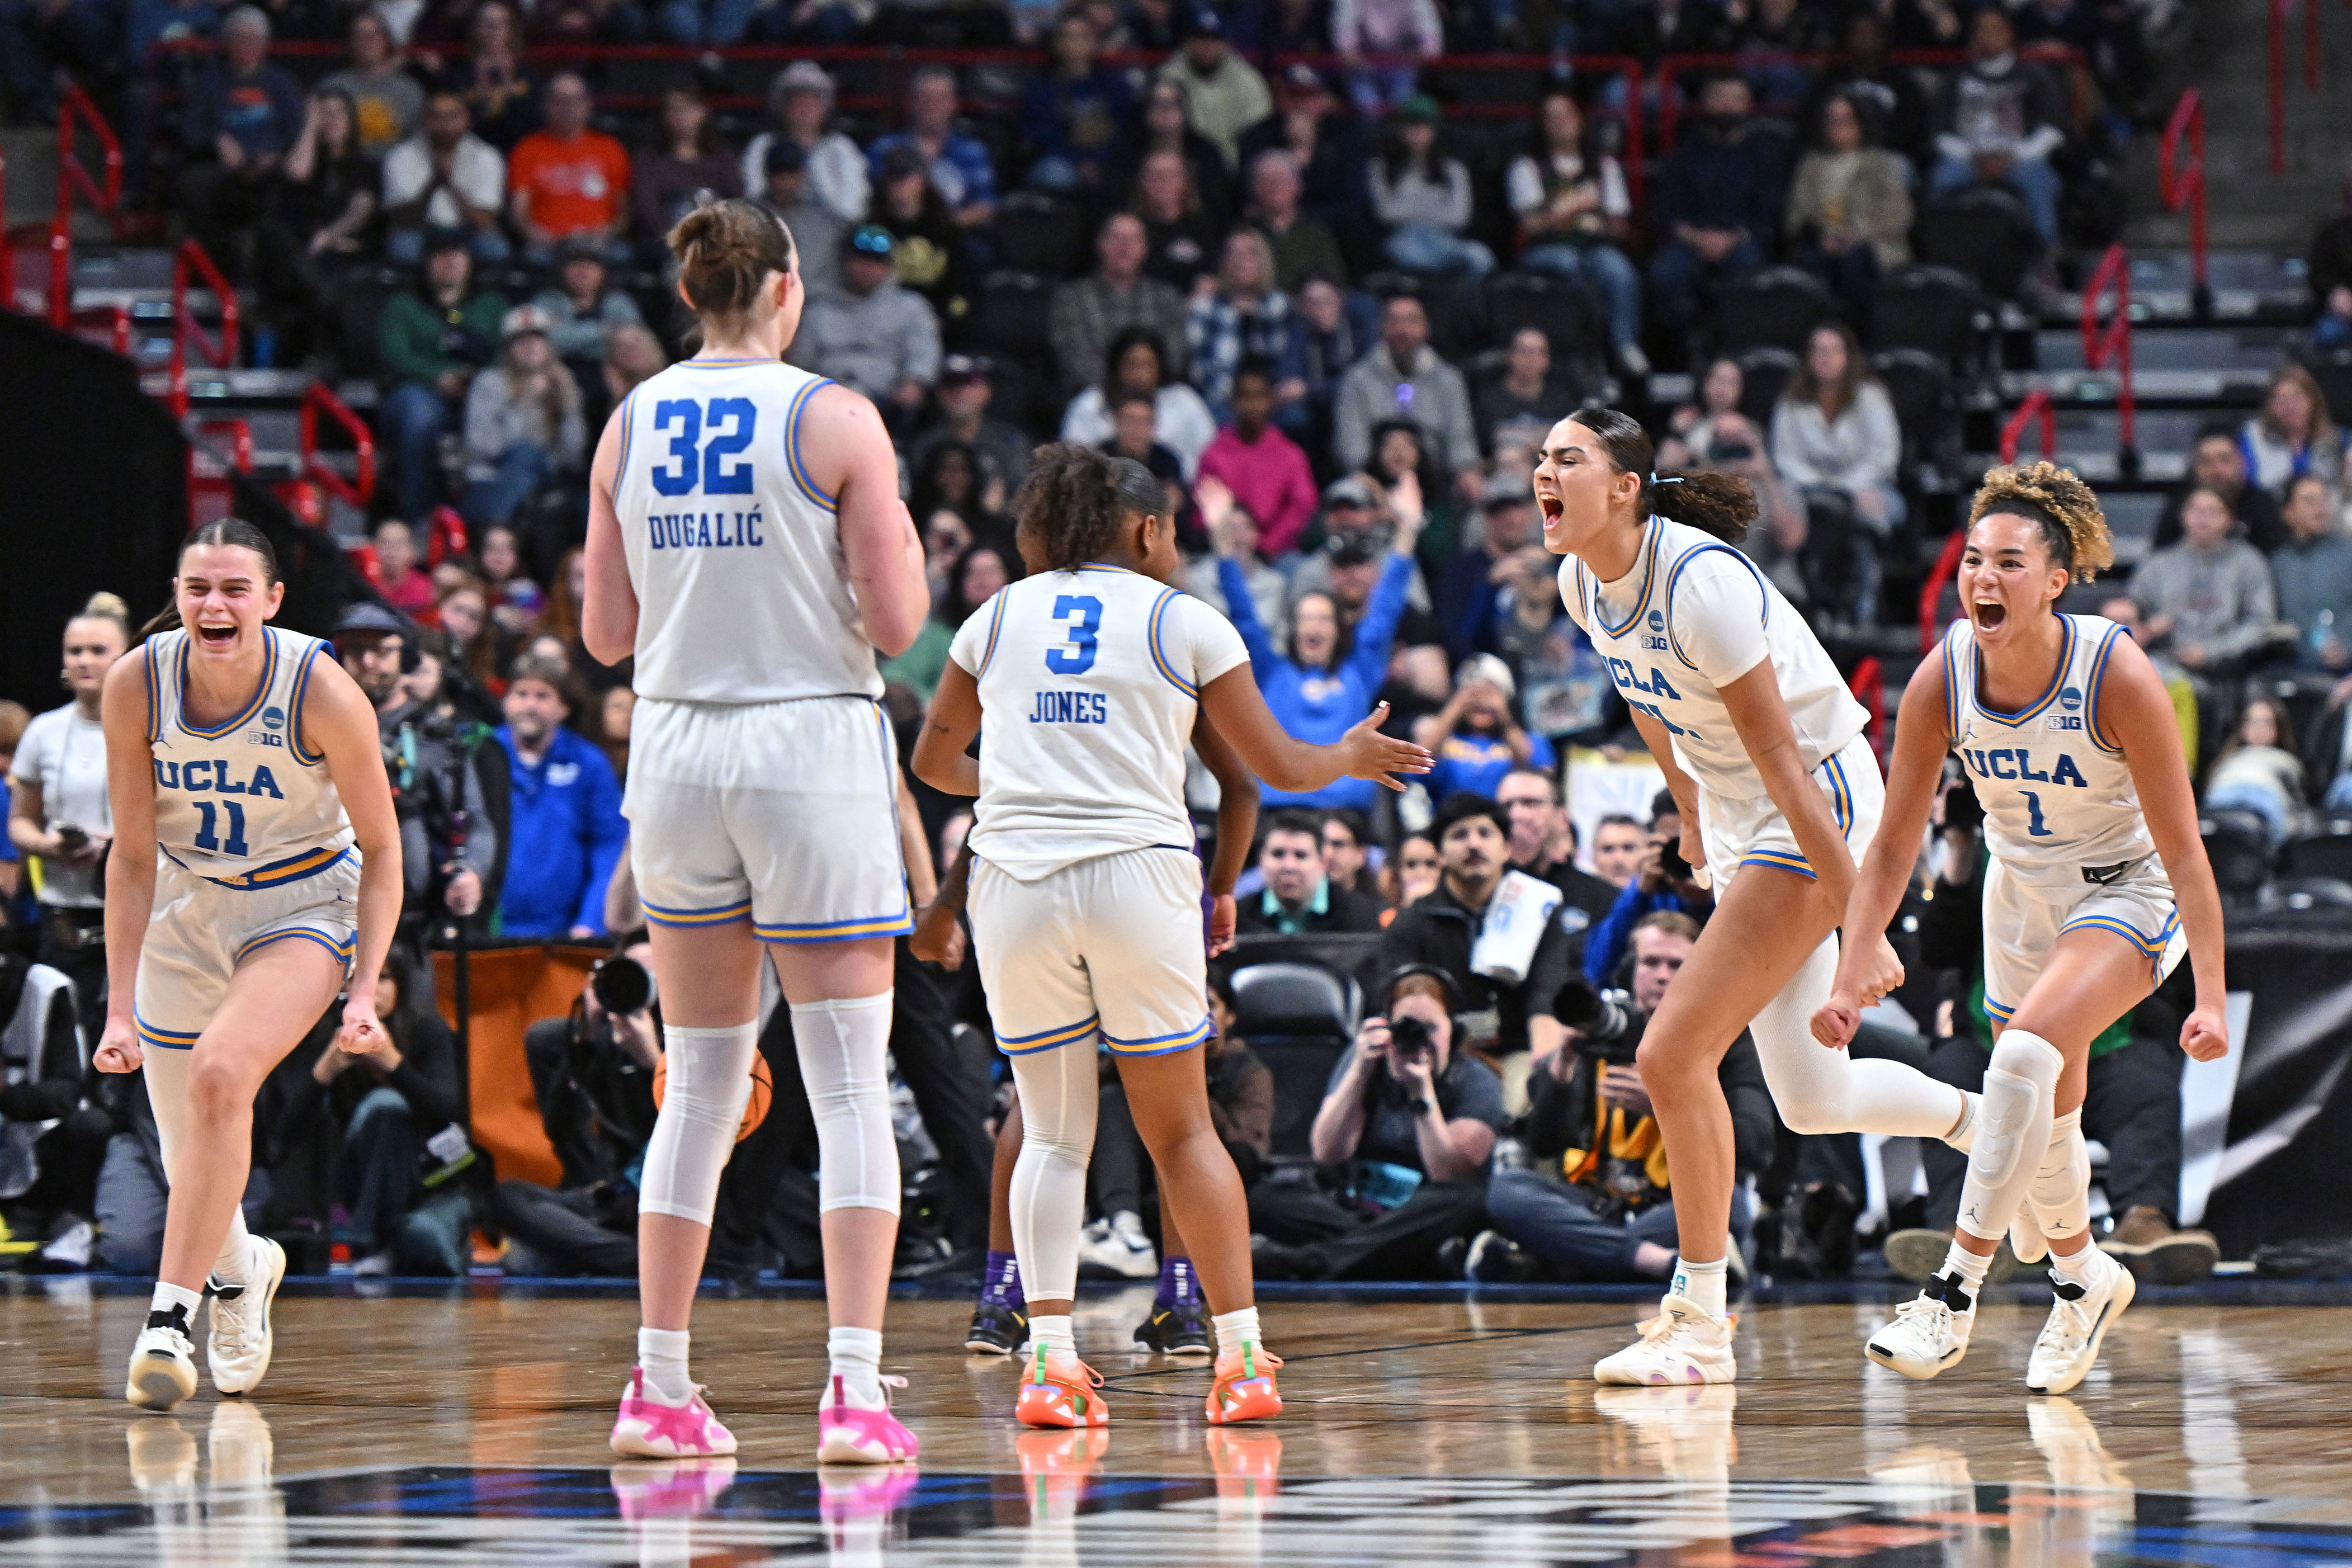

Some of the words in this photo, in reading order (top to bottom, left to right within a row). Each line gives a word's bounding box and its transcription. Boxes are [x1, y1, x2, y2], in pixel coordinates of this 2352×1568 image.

[651, 398, 757, 496] 32
[648, 504, 764, 549] DUGALIĆ
[1046, 595, 1103, 675] 3
[1029, 691, 1106, 724] JONES
[154, 758, 285, 799] UCLA
[1963, 748, 2088, 787] UCLA
[192, 799, 248, 857] 11
[2018, 791, 2053, 837] 1
